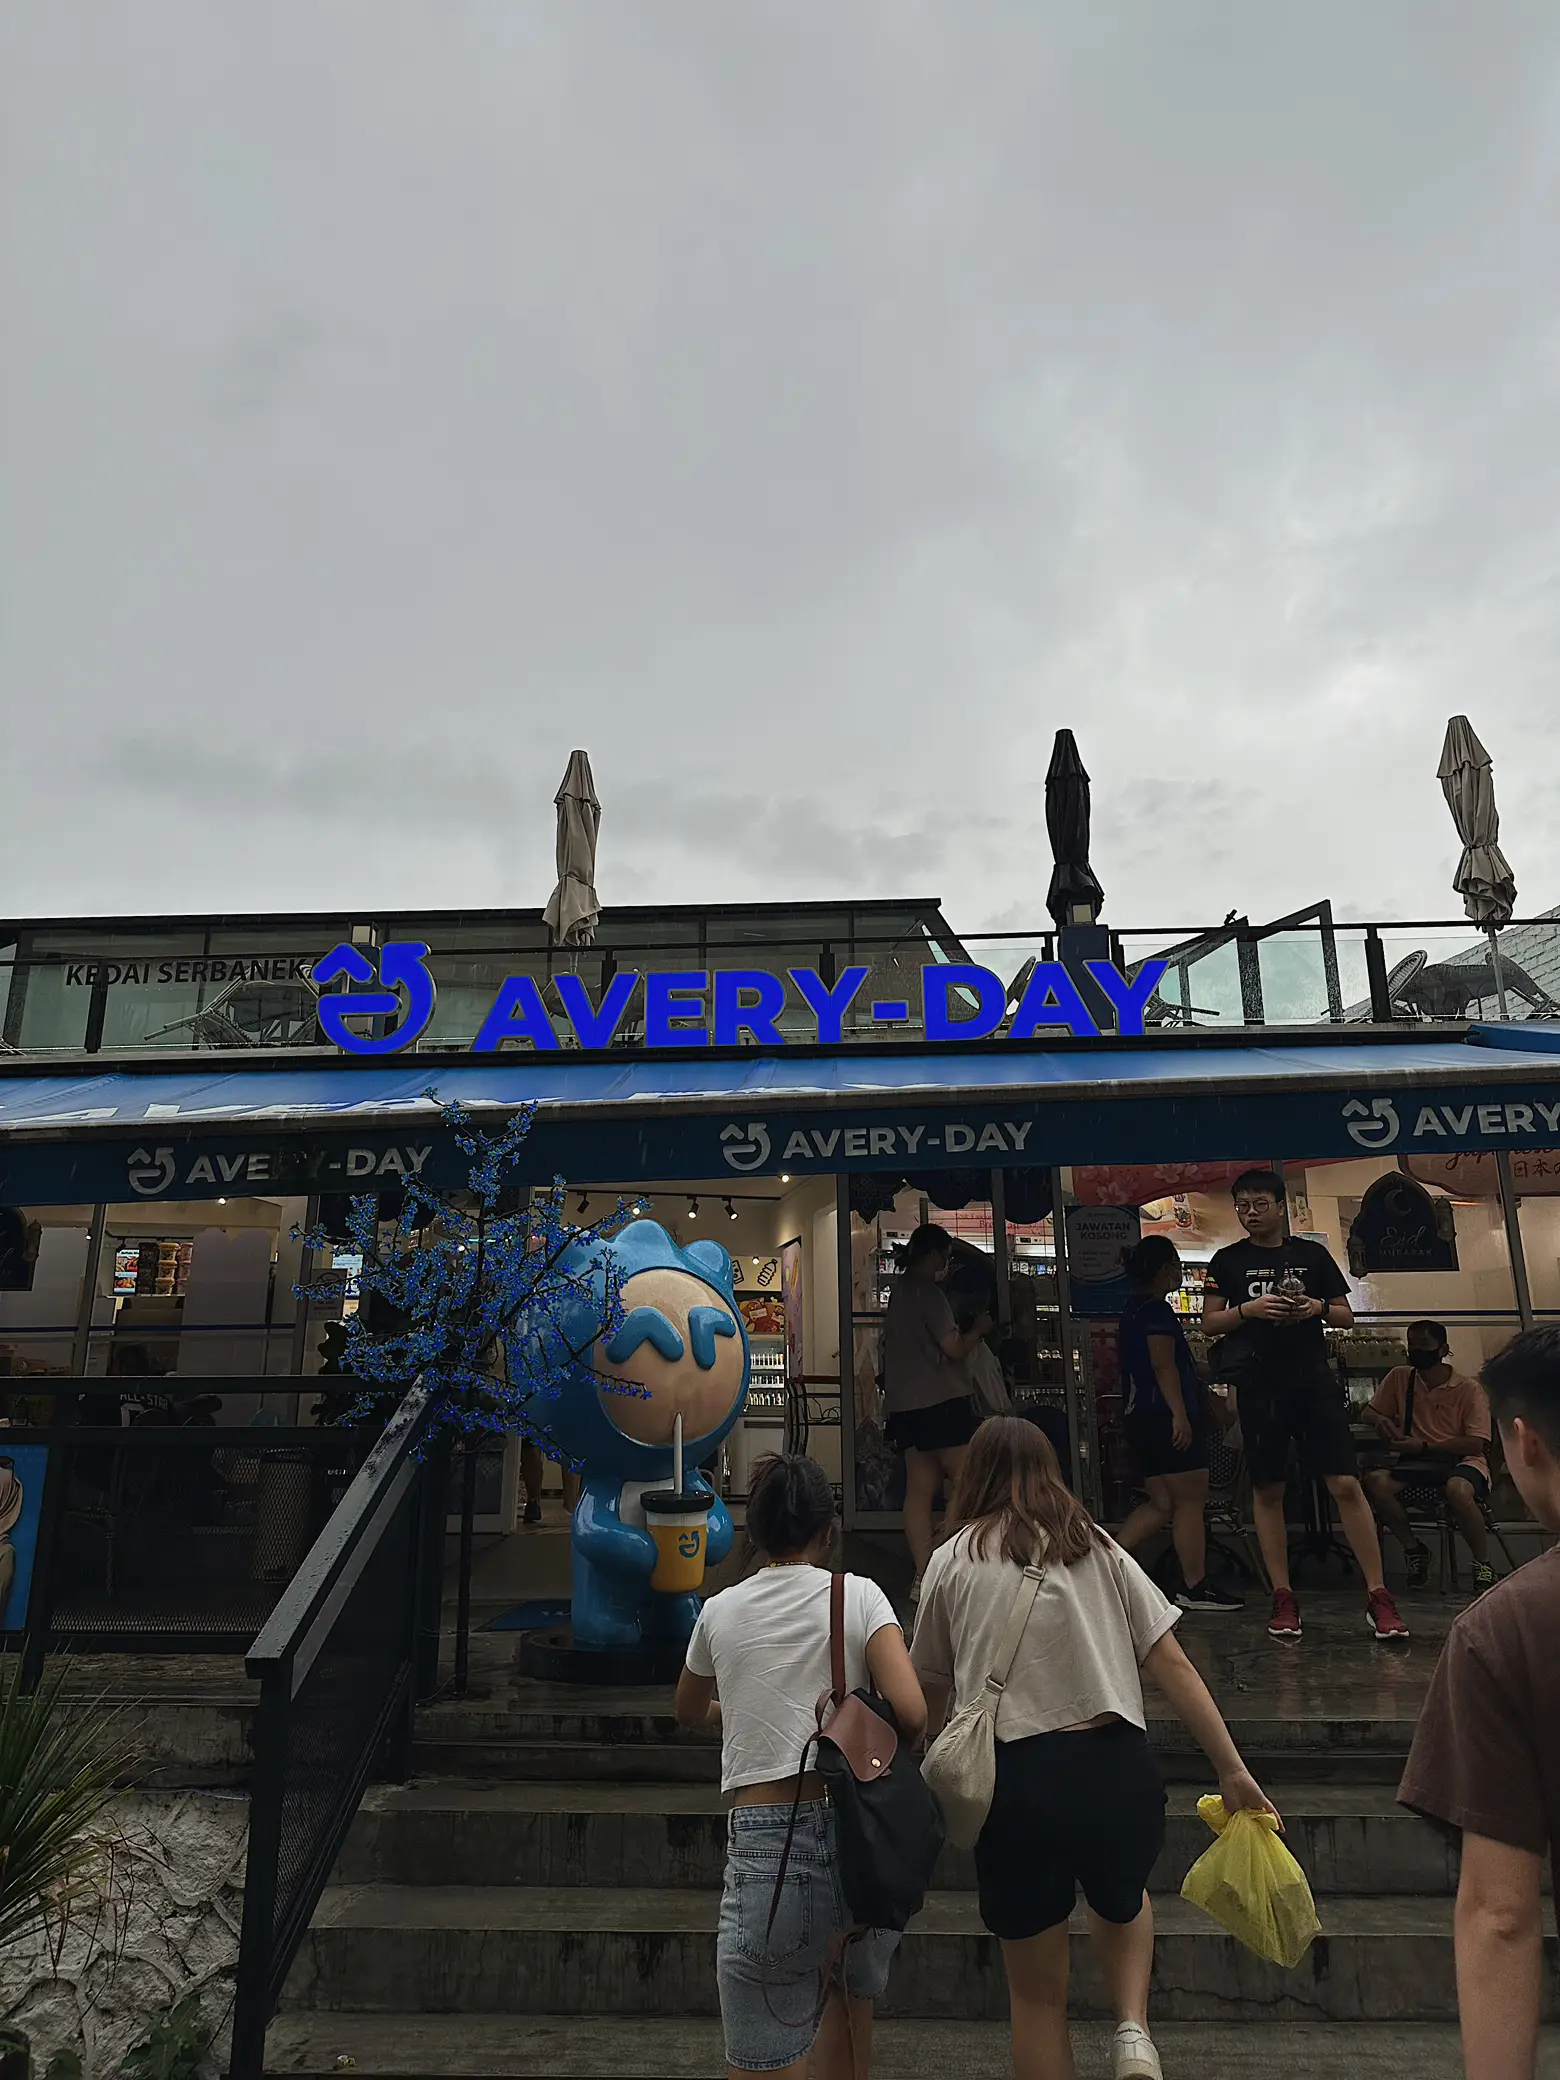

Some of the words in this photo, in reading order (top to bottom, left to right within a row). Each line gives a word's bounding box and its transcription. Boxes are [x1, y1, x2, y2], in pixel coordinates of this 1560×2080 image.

[66, 963, 150, 986] KEDAI
[472, 957, 1172, 1052] AVERY-DAY
[783, 1121, 1032, 1160] AVERY-DAY
[186, 1147, 431, 1185] AVE-DAY
[1075, 1221, 1131, 1231] JAWATAN
[1080, 1231, 1128, 1240] KOSONG
[1379, 1225, 1428, 1248] Eid
